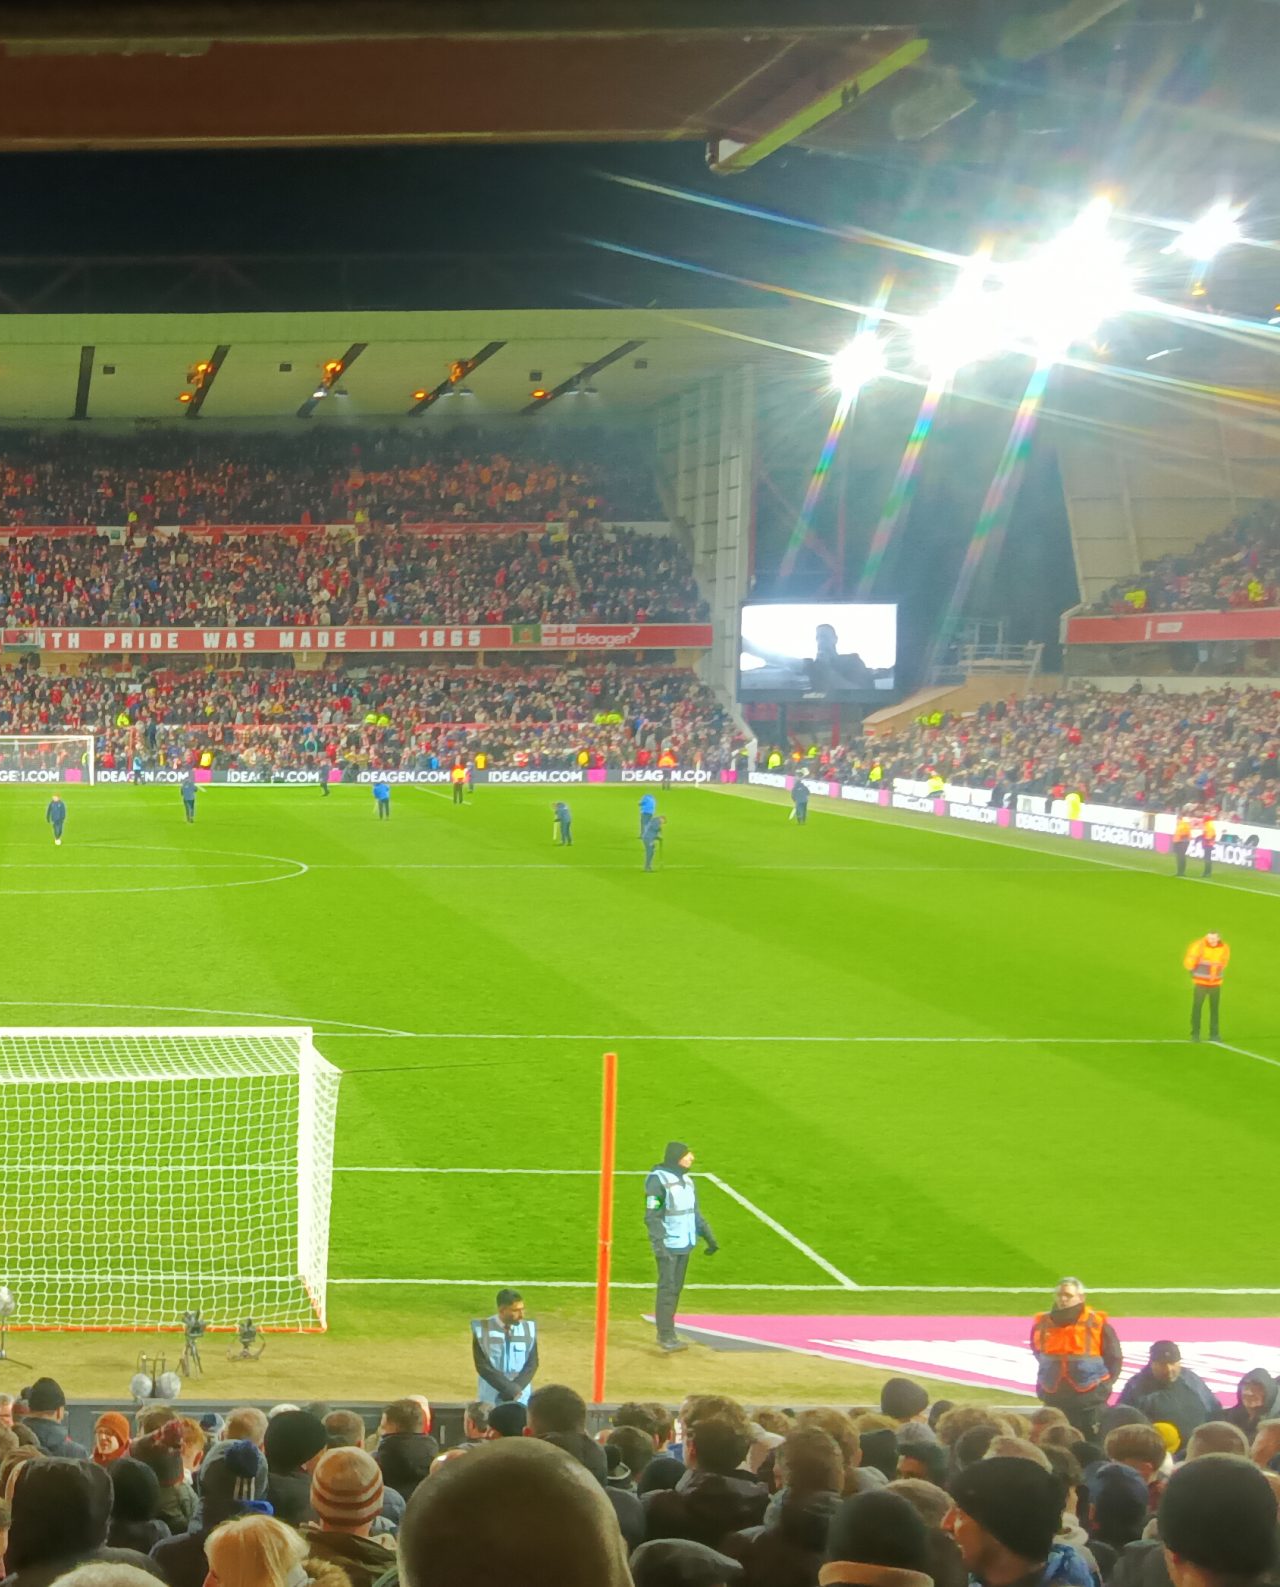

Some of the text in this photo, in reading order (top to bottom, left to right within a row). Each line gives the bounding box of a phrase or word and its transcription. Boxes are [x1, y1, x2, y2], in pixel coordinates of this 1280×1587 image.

[104, 632, 178, 648] PRIDE
[203, 632, 255, 648] WAS
[279, 632, 346, 648] MADE
[370, 631, 395, 647] IN
[419, 630, 480, 646] 1865
[357, 769, 450, 783] IDEAGEN.COM
[488, 769, 582, 783] IDEAGEN.COM
[622, 770, 711, 782] IDEAGN.CO
